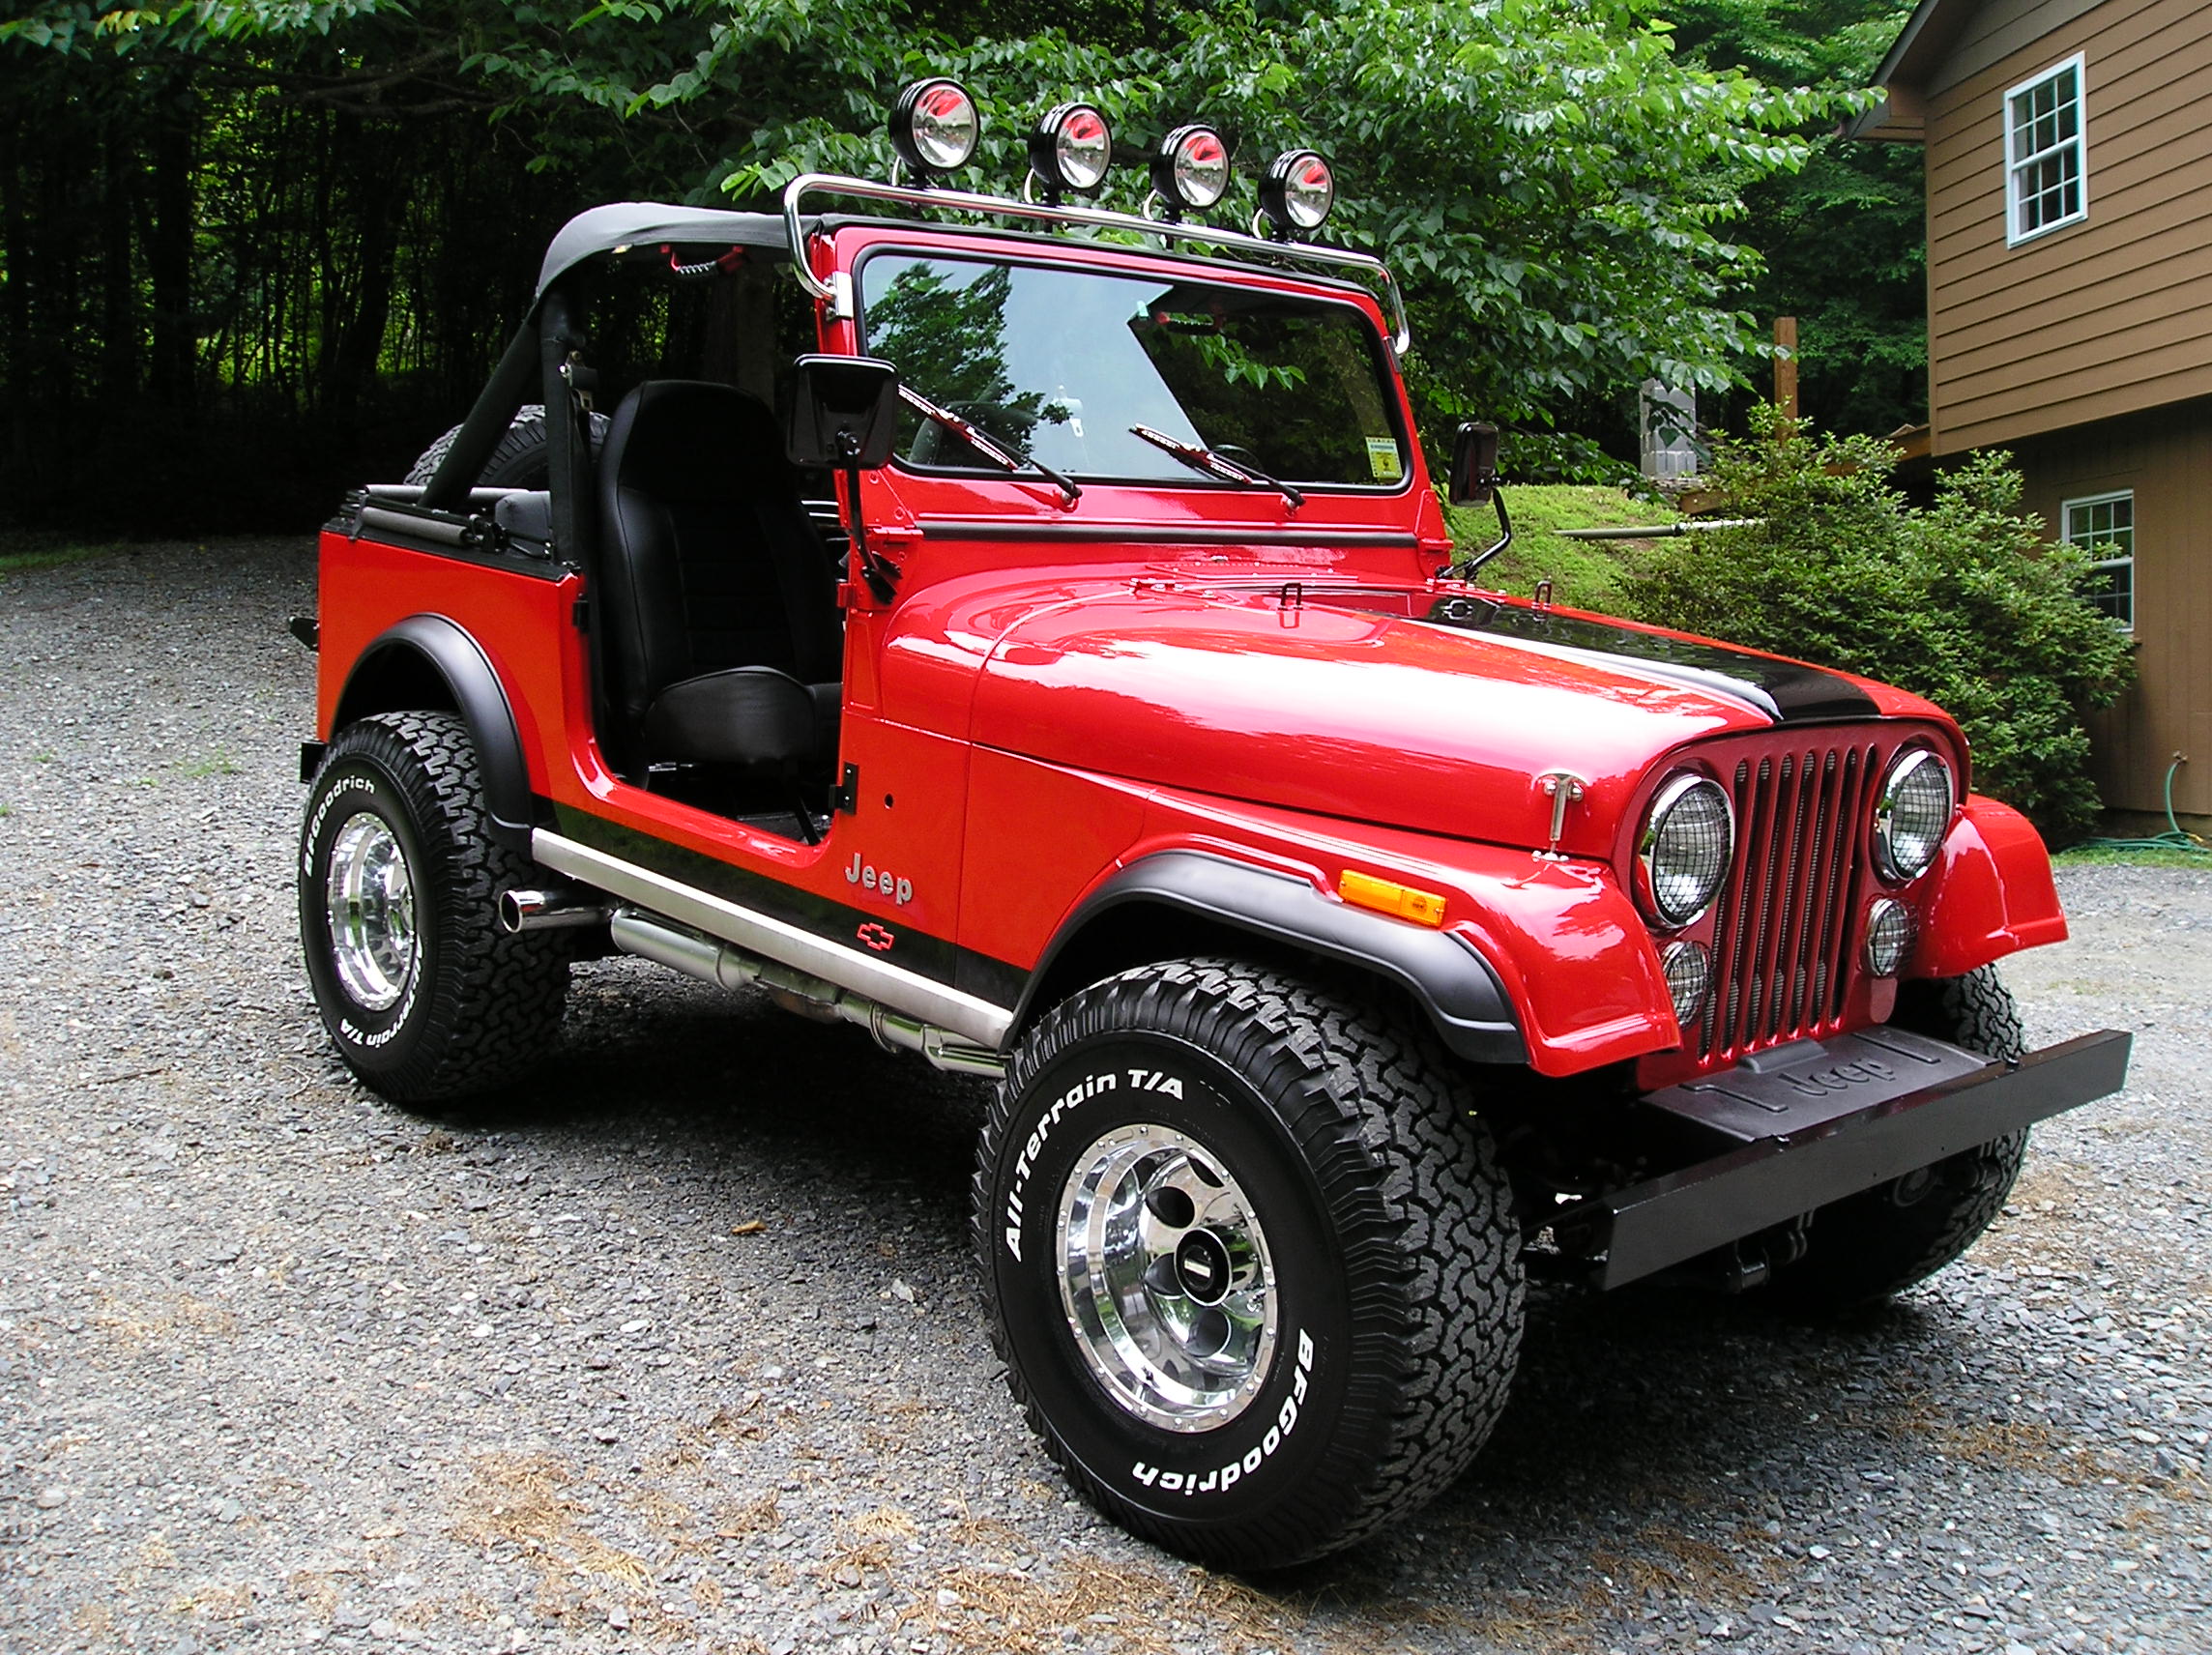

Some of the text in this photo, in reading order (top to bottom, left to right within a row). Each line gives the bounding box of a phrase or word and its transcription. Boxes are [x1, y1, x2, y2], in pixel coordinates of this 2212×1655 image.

[305, 775, 375, 877] BFGoodrich
[845, 852, 913, 905] Jeep
[340, 1018, 364, 1045] T/A
[1777, 1058, 1897, 1096] Jeep
[1006, 1069, 1183, 1262] All-Terrain T/A
[1132, 1328, 1314, 1495] BFGoodrich
